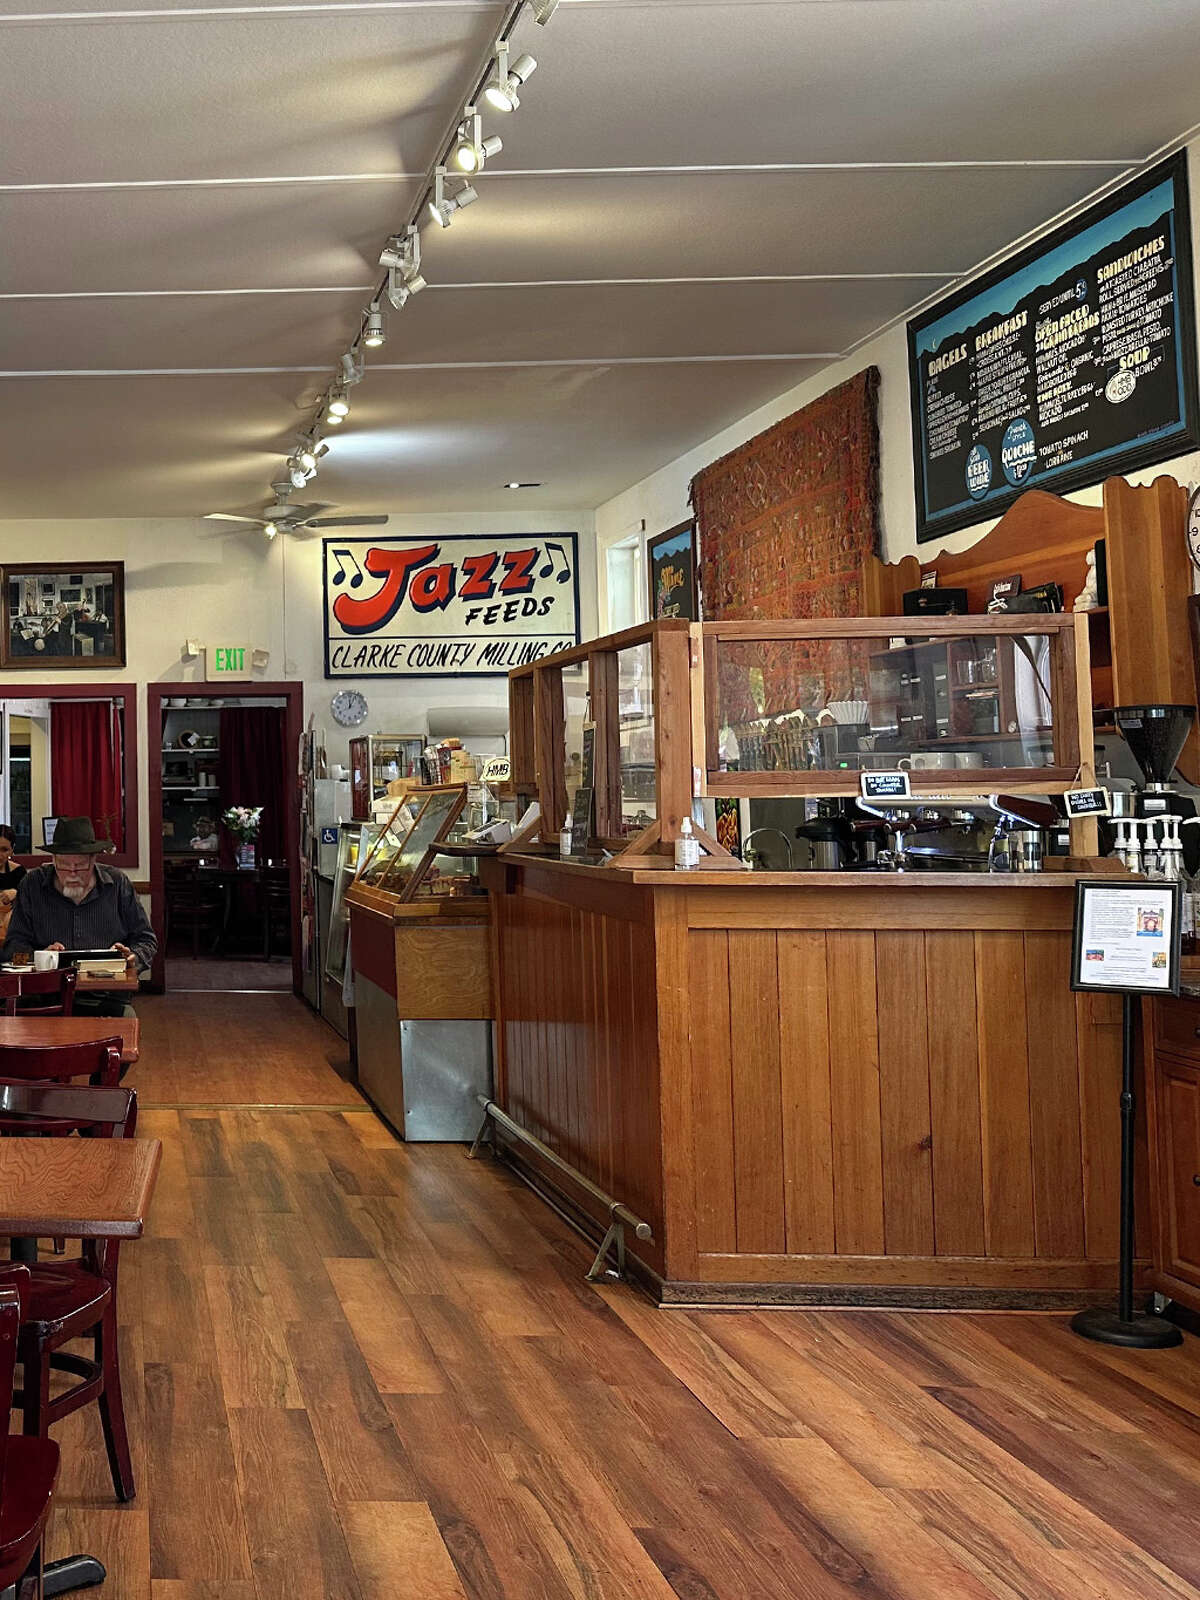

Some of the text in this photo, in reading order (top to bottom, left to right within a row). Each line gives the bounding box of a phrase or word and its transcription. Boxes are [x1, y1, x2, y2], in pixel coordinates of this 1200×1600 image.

[1096, 234, 1165, 284] SANDWICHES
[975, 309, 1029, 351] BREAKFAST
[1059, 302, 1089, 330] FACED
[927, 342, 967, 377] BAGELS
[1119, 344, 1150, 371] SOUP
[1002, 440, 1035, 468] QUICHE
[1038, 429, 1088, 457] TOMATO SPINACH
[465, 597, 555, 626] FEEDS
[215, 648, 246, 671] EXIT
[331, 645, 406, 669] CLARKE
[407, 642, 476, 668] COUNTY
[477, 641, 546, 666] MILLING
[486, 763, 509, 777] HMB
